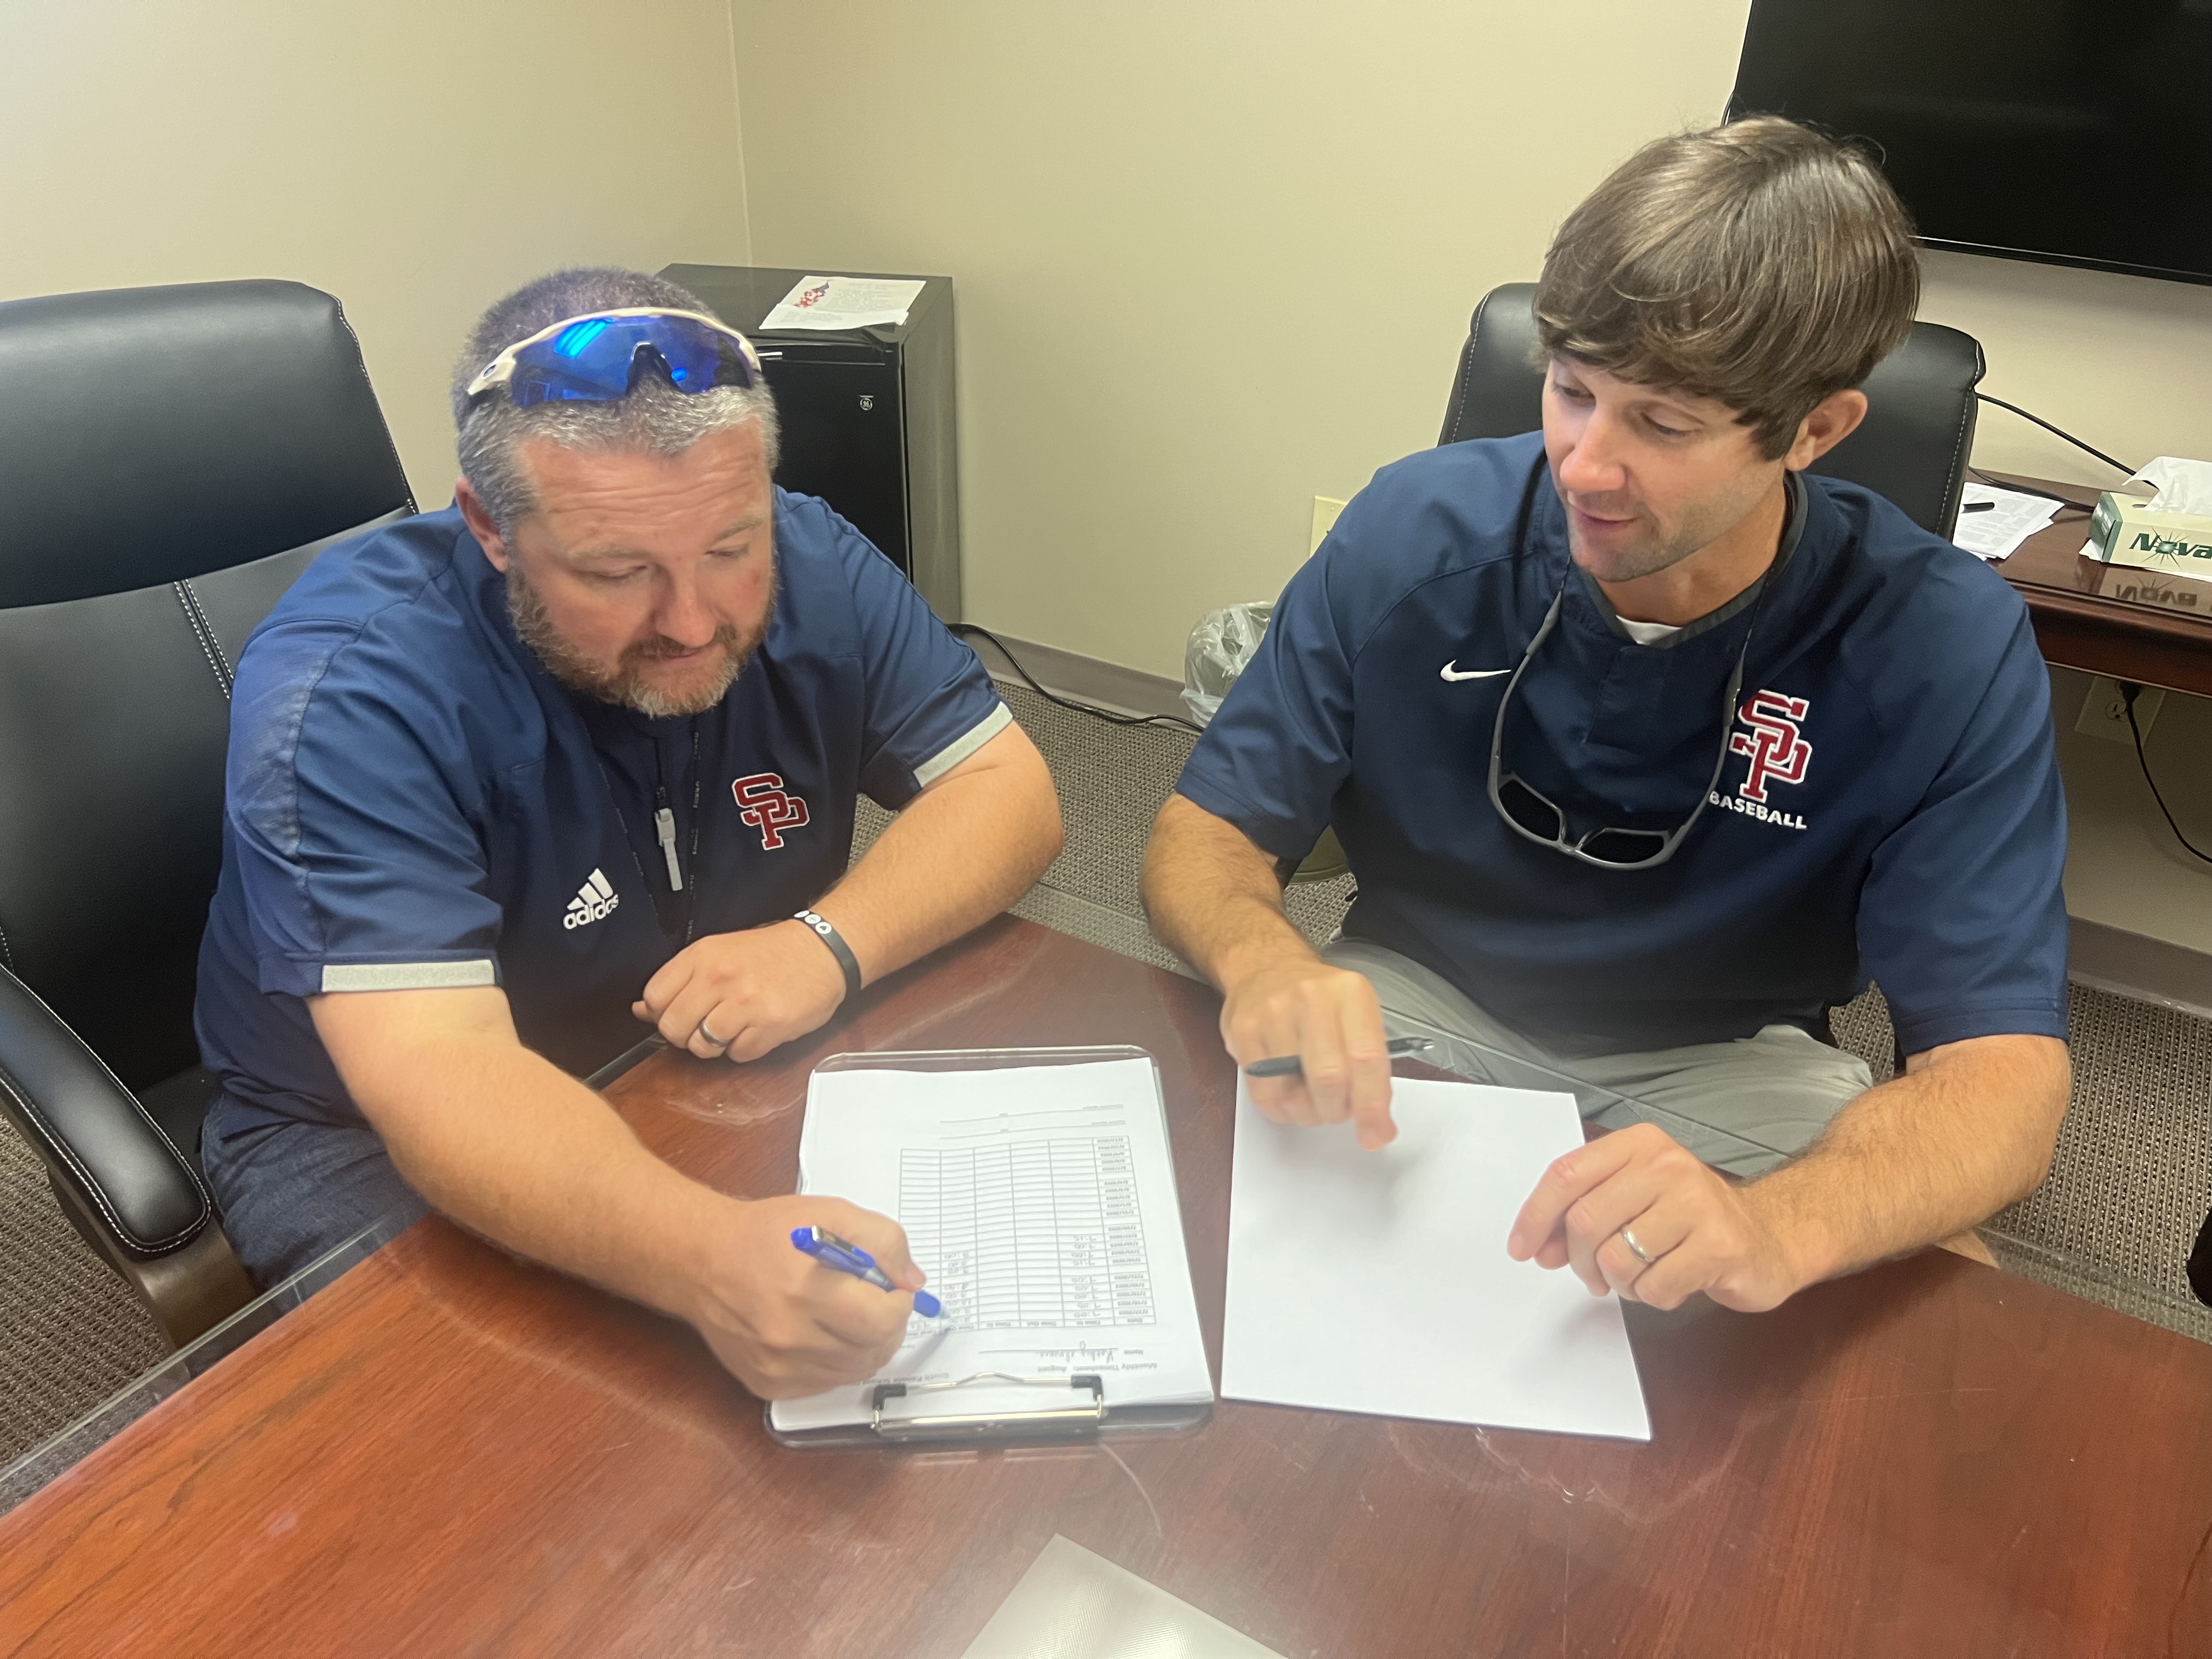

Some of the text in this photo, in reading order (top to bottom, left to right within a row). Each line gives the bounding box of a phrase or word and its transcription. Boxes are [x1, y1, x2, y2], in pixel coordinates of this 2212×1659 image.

[2129, 533, 2212, 559] Nova
[1728, 689, 1812, 803] SP
[731, 772, 810, 850] SP
[1708, 791, 1807, 830] BASEBALL
[563, 894, 619, 930] adidas
